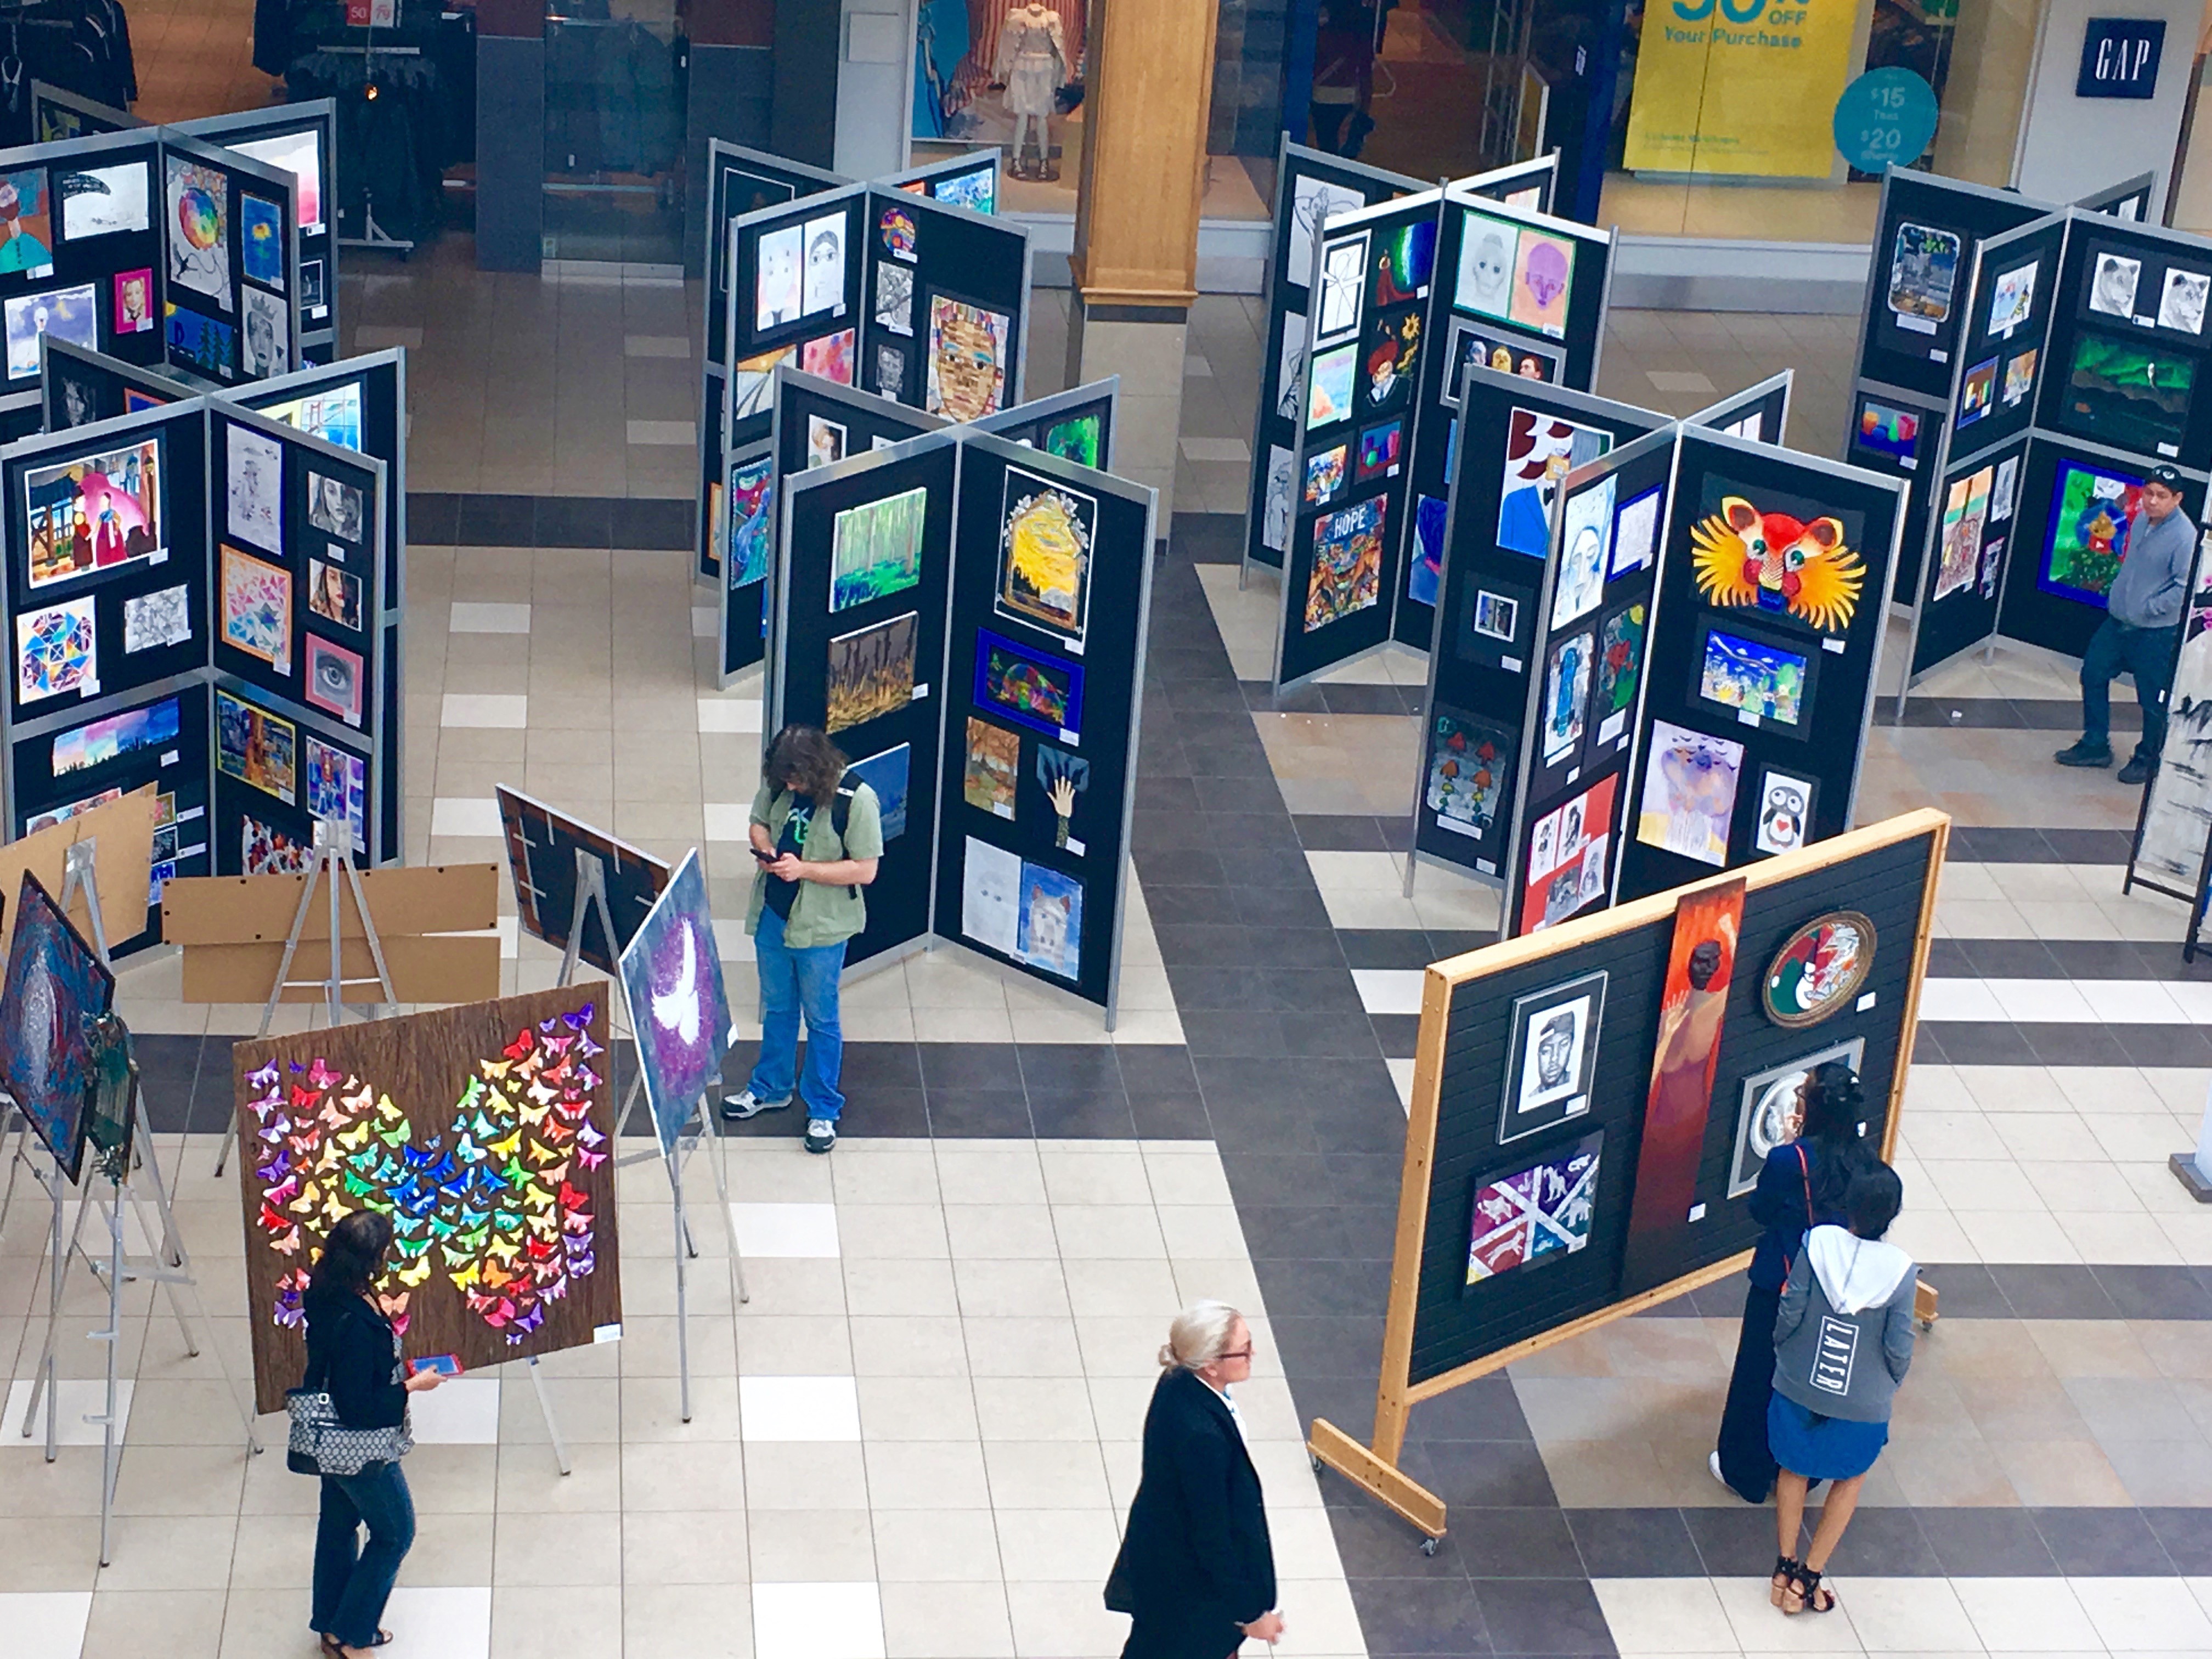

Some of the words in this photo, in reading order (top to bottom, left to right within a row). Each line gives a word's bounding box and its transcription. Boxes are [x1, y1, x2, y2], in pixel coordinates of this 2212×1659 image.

[351, 6, 366, 19] 50
[1768, 9, 1807, 25] OFF
[1664, 26, 1705, 43] Your
[1712, 28, 1802, 48] Purchase
[2095, 38, 2150, 81] GAP
[1871, 87, 1905, 109] $15
[1860, 127, 1901, 149] $20
[1334, 506, 1367, 539] HOPE
[1816, 1323, 1853, 1390] LATER
